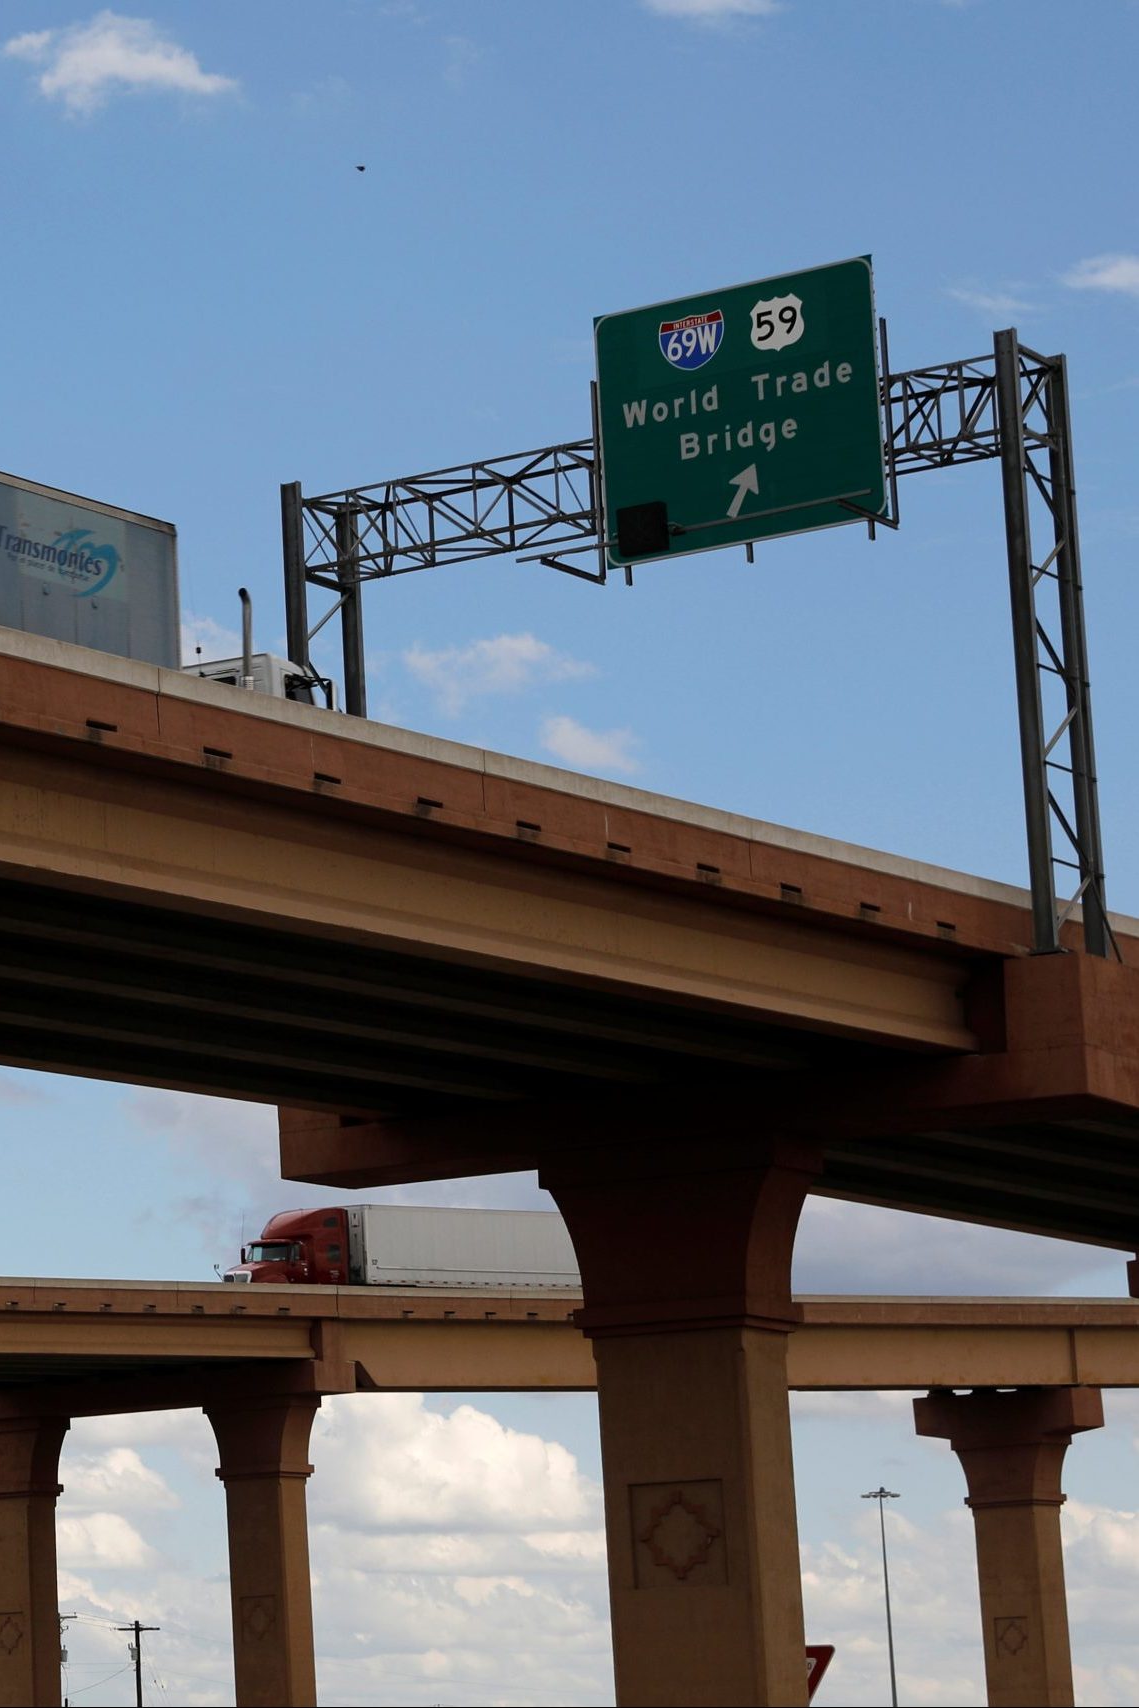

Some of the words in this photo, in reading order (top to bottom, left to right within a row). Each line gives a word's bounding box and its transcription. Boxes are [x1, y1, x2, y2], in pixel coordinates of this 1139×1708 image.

[673, 316, 708, 330] INTERSTATE
[756, 305, 797, 341] 59
[667, 324, 717, 362] 69W
[622, 385, 718, 428] World
[751, 360, 852, 400] Trade
[680, 418, 798, 460] Bridge
